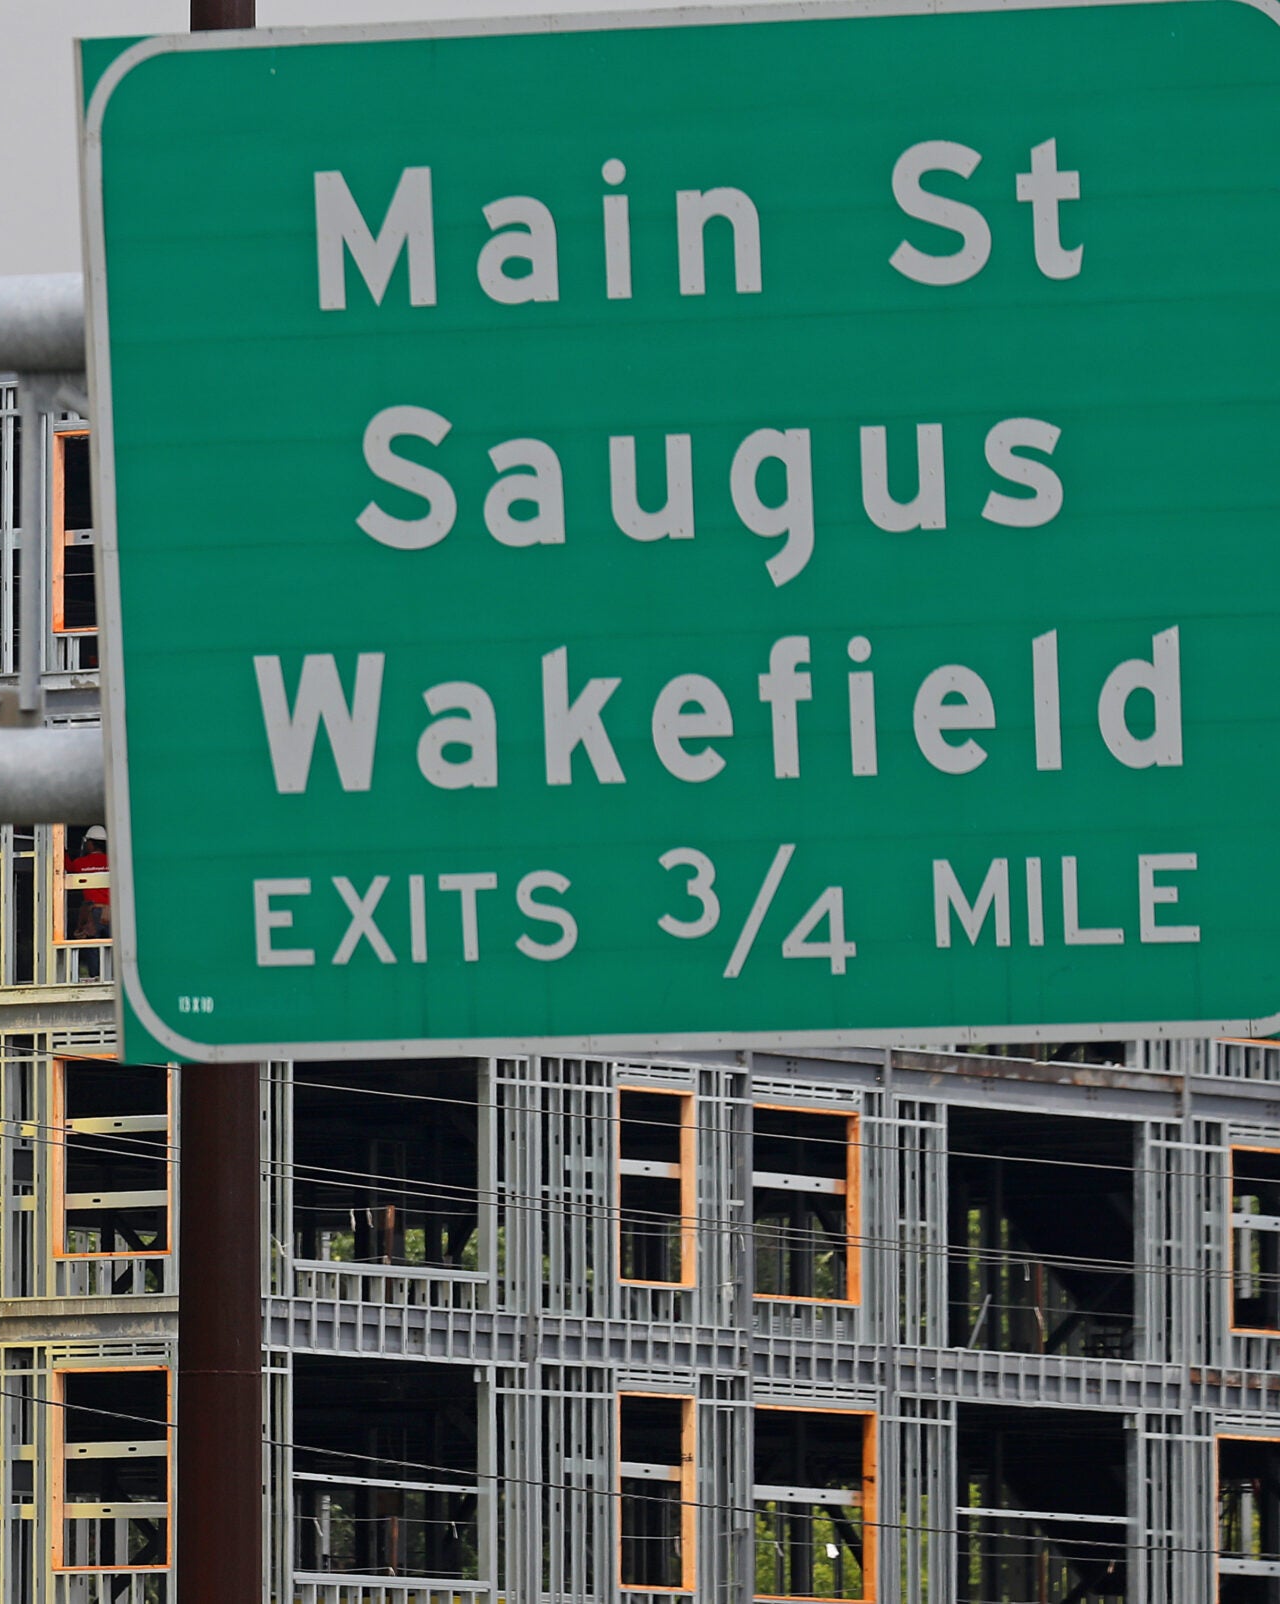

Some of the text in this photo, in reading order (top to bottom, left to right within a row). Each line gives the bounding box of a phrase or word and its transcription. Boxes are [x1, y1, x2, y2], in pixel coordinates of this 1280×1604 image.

[315, 138, 1083, 310] Main St
[356, 406, 1063, 587] Saugus
[254, 626, 1183, 793] Wakefield
[254, 844, 1200, 978] EXITS 3/4 MILE
